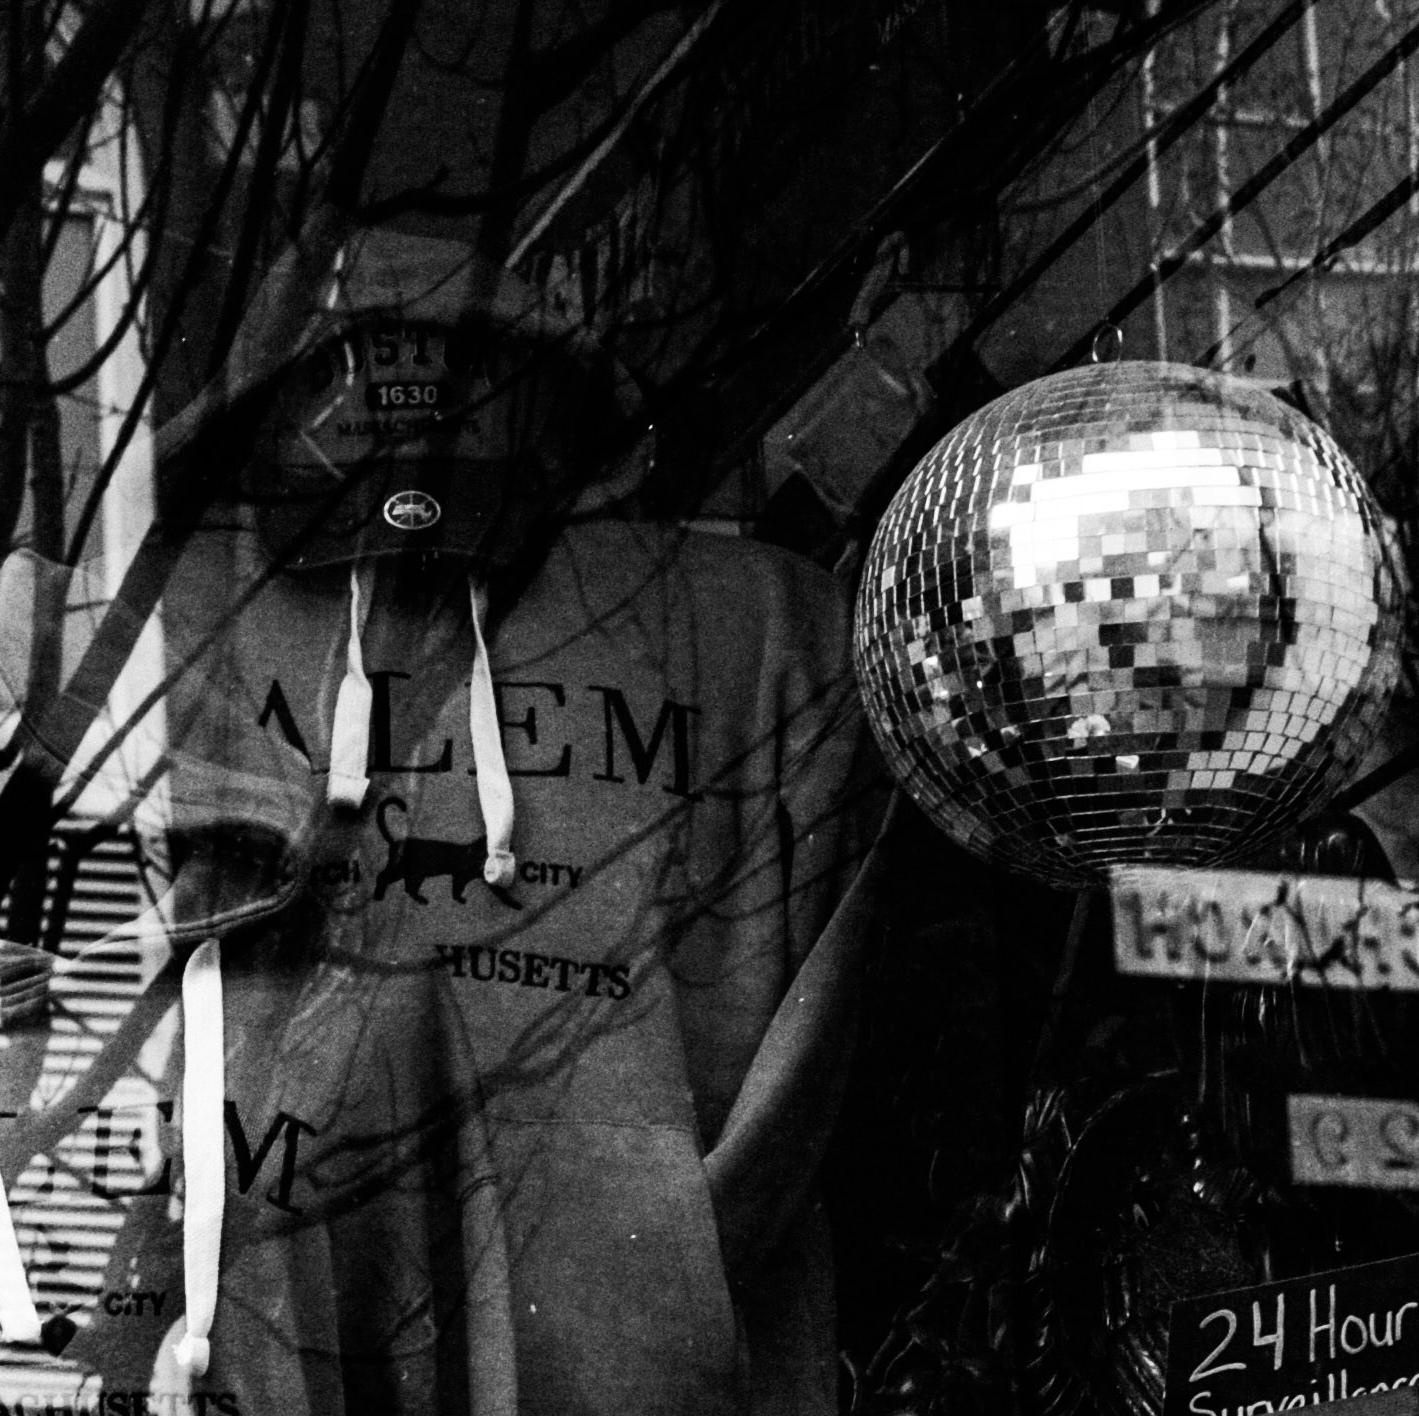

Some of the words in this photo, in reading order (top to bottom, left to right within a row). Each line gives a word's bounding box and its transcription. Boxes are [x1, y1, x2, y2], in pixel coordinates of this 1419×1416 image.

[377, 384, 439, 406] 1630
[258, 670, 703, 802] ALEM
[520, 860, 584, 889] CITY
[434, 943, 632, 1000] HUSETTS
[103, 1291, 168, 1317] CITY
[1189, 1292, 1285, 1383] 24
[1309, 1283, 1419, 1363] Hour
